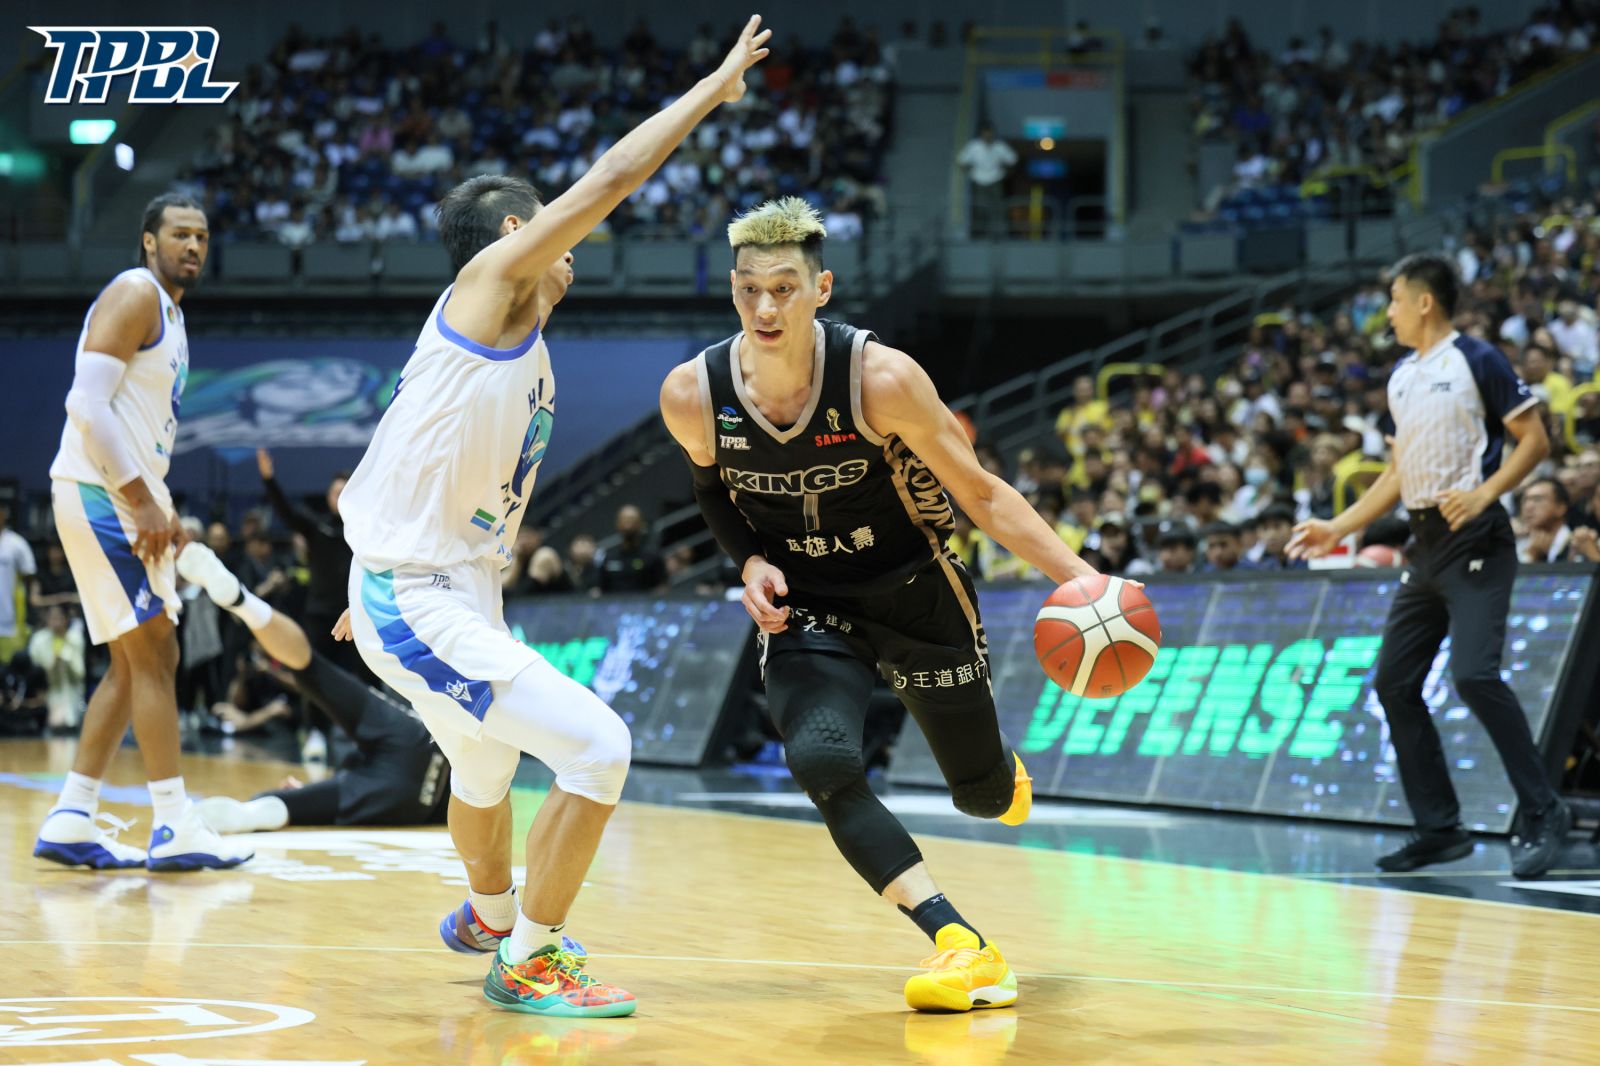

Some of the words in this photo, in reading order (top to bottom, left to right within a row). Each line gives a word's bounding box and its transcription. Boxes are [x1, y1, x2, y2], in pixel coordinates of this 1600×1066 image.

[720, 435, 751, 450] TPBL
[726, 459, 868, 496] KINGS
[911, 659, 987, 688] 王道銀行
